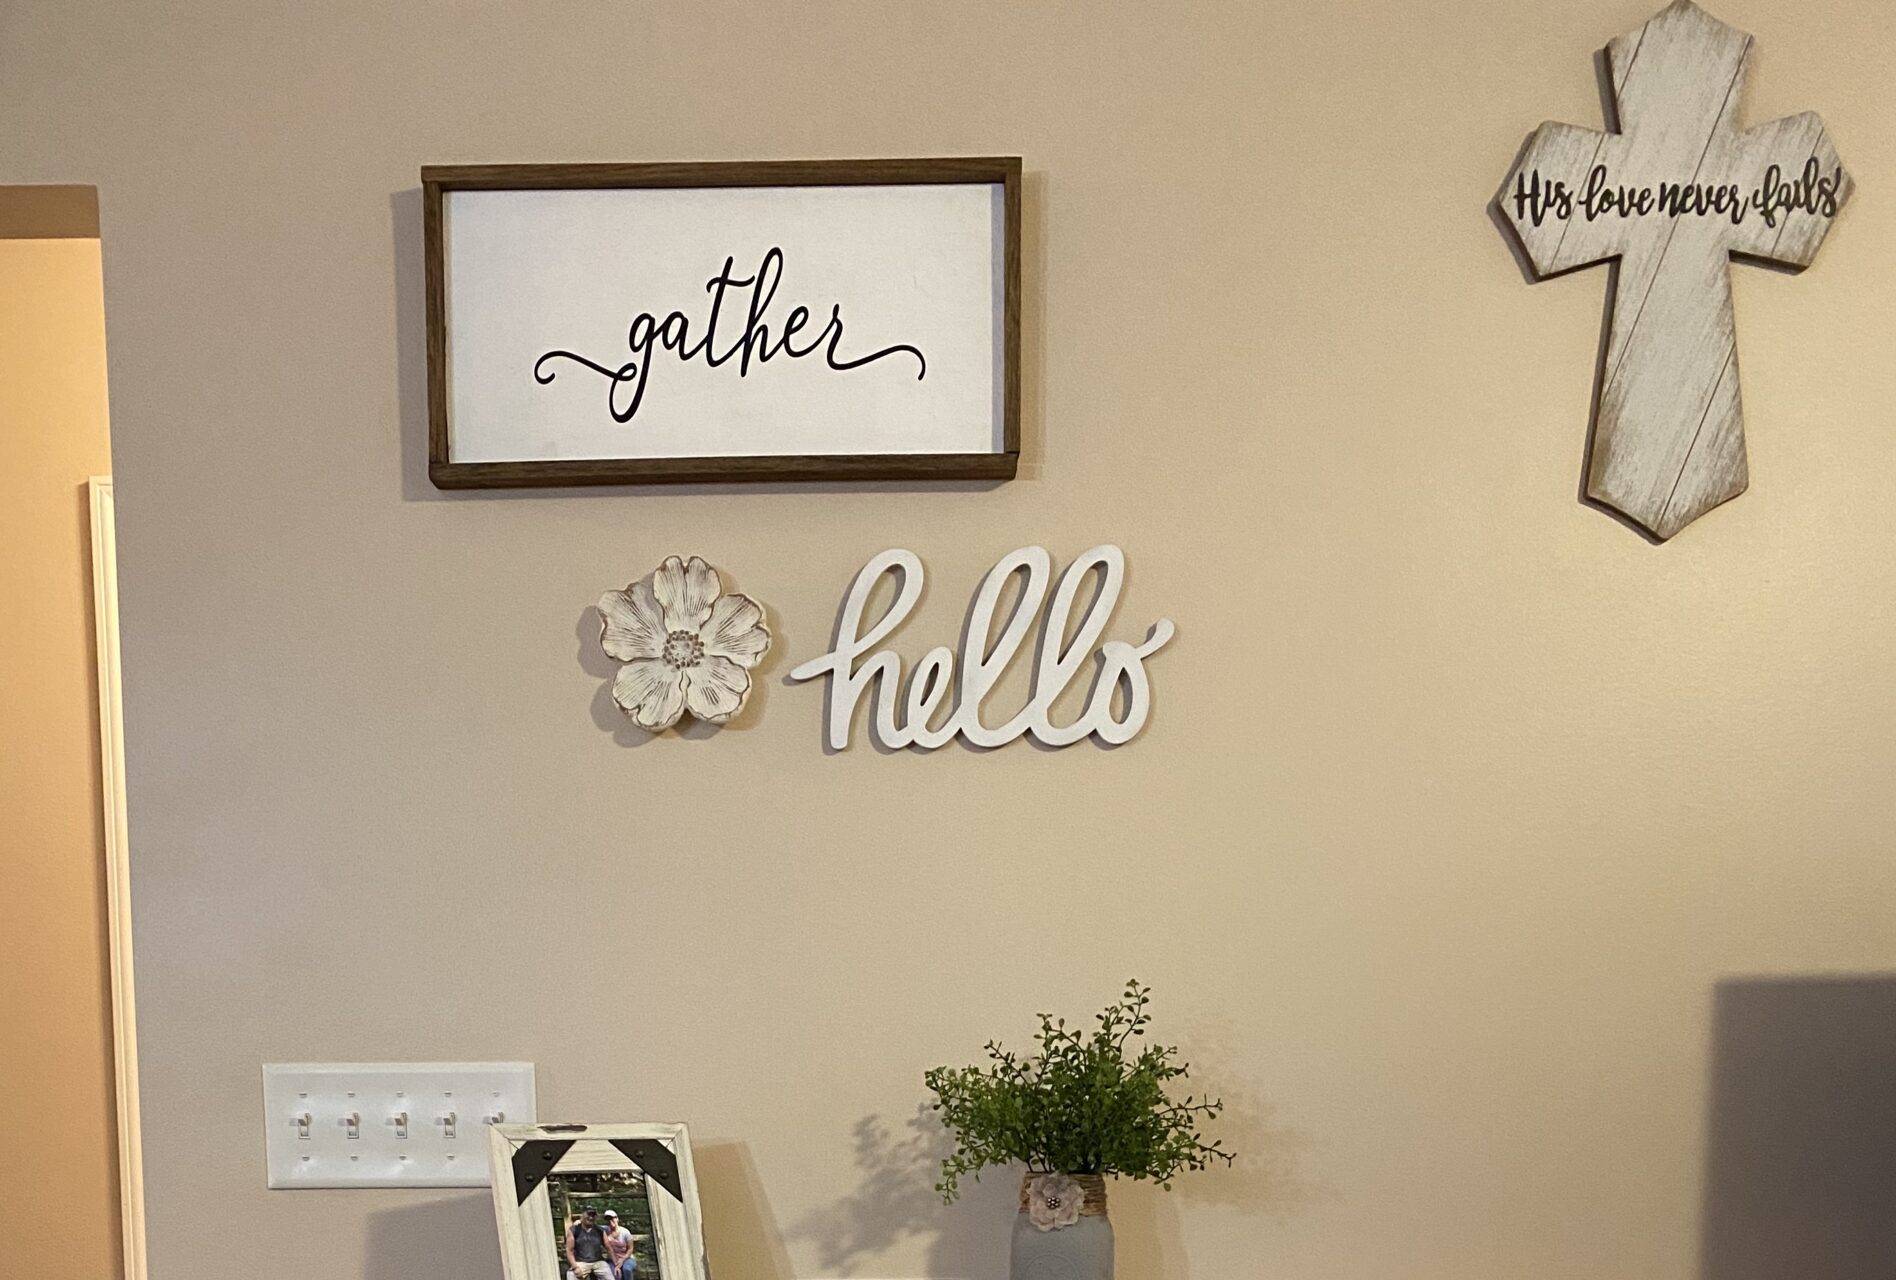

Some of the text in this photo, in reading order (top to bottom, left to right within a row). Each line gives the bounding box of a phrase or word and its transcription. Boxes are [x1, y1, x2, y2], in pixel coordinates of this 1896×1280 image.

[1513, 156, 1842, 229] His love never fails
[534, 246, 926, 423] gather
[791, 544, 1175, 750] hello
